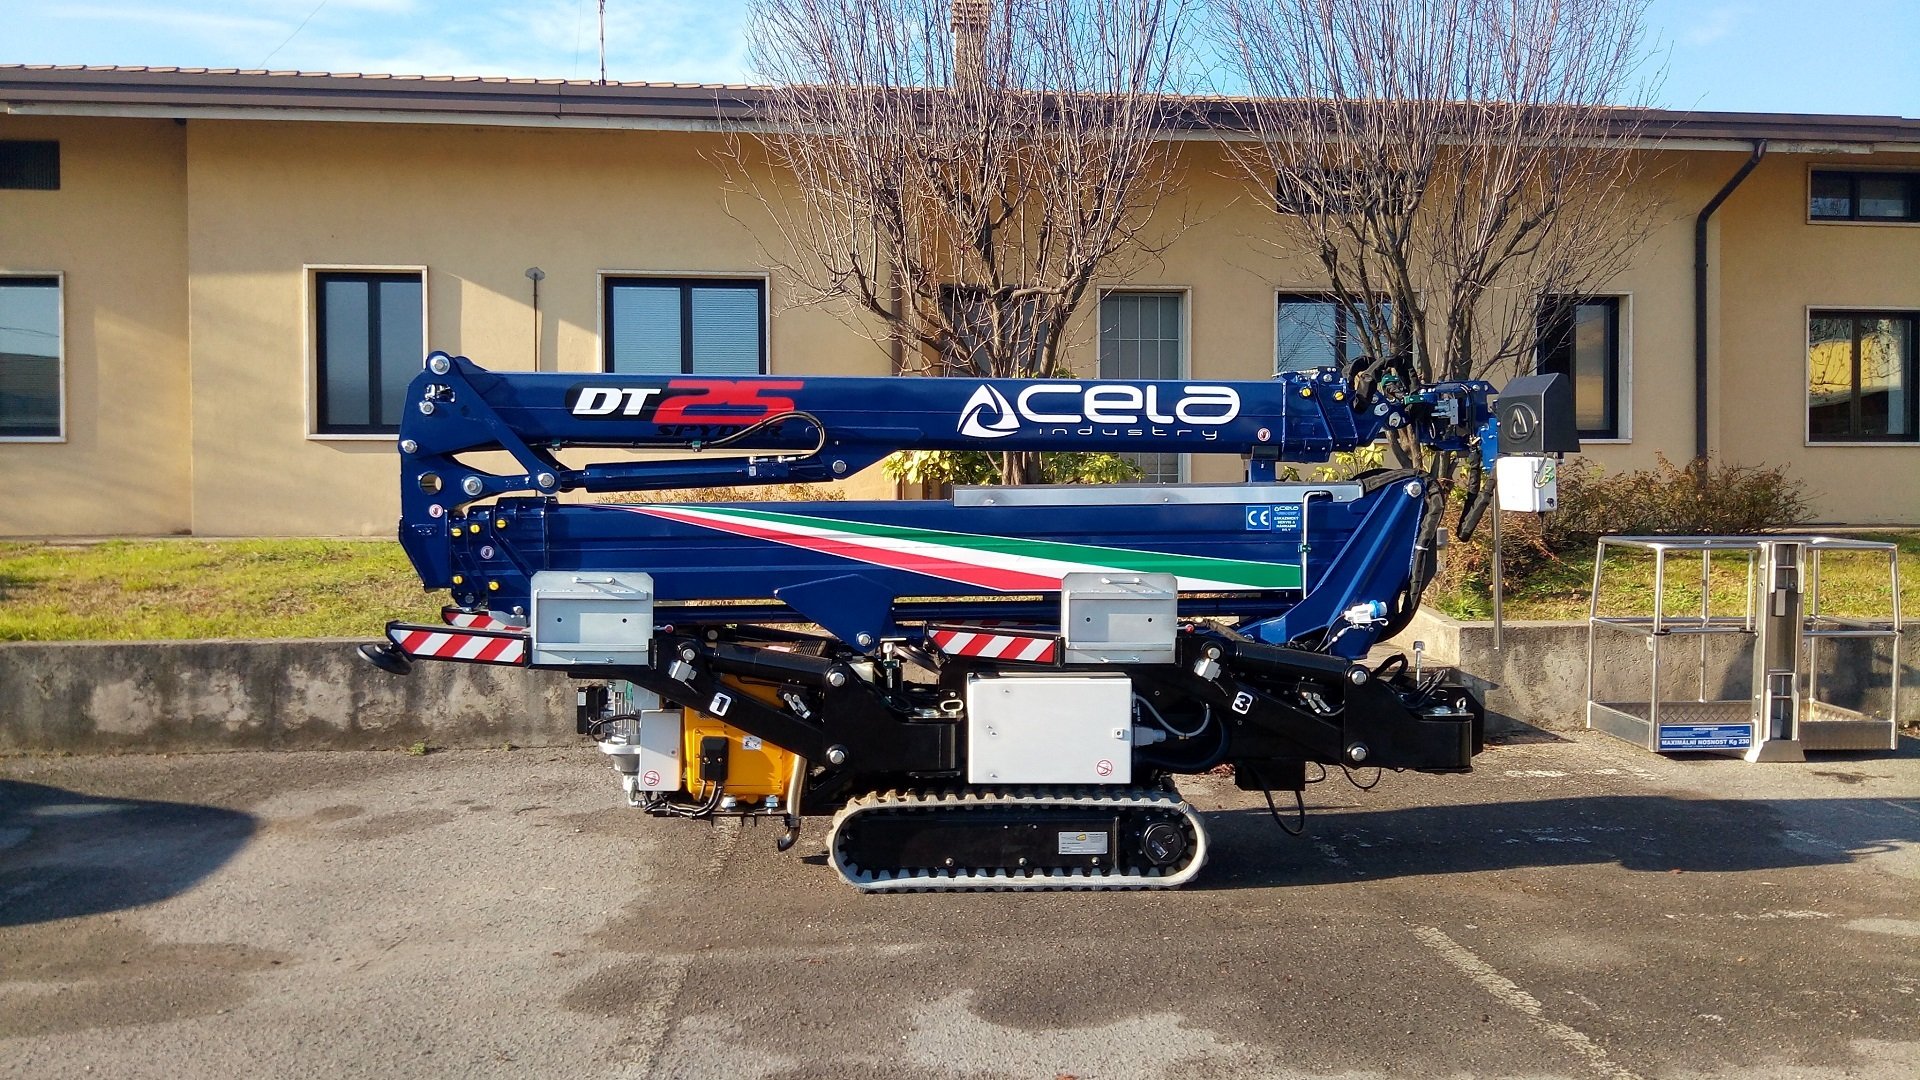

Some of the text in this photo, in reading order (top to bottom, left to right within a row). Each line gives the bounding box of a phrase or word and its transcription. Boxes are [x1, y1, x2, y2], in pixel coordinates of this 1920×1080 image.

[572, 379, 804, 425] DT 25
[655, 424, 784, 437] SPYDR
[1039, 425, 1218, 440] industry
[1248, 510, 1269, 526] CE
[717, 696, 728, 713] 1
[1234, 694, 1250, 711] 3
